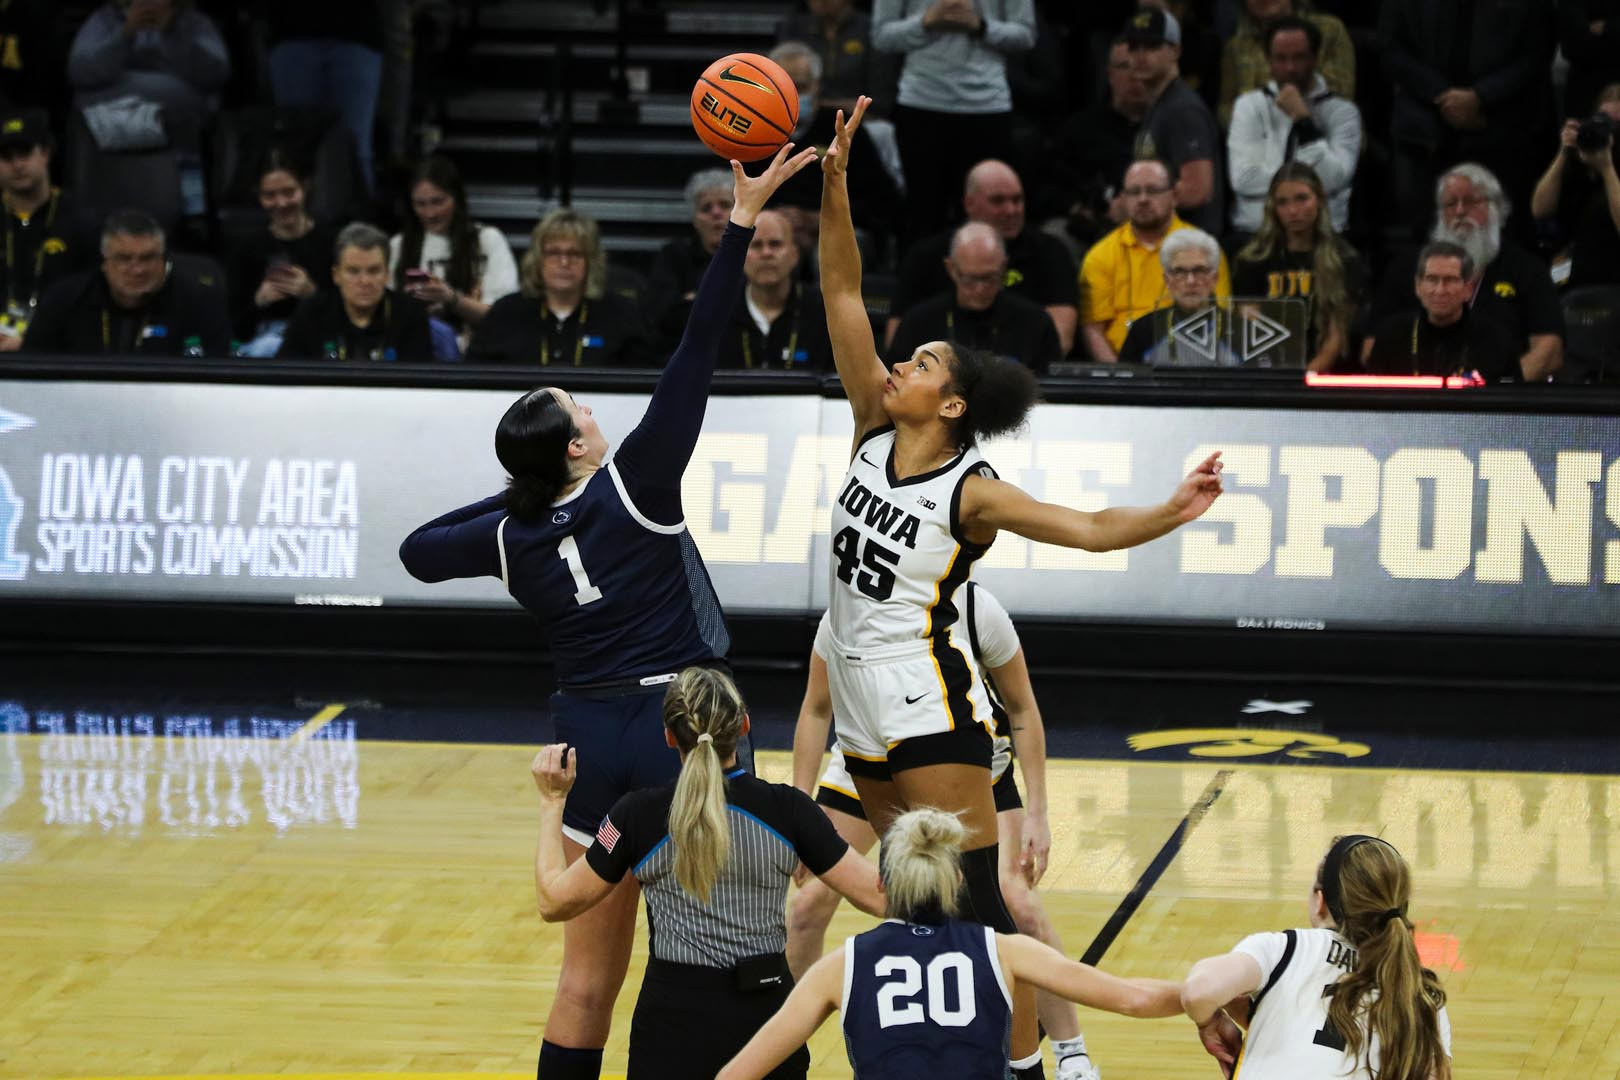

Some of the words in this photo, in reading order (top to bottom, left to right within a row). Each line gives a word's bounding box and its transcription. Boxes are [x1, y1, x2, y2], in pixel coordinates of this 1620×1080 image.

[701, 92, 753, 134] ELITE
[40, 452, 145, 523] IOWA
[157, 455, 249, 525] CITY
[257, 458, 358, 527] AREA
[681, 432, 1133, 572] GAE
[1179, 442, 1620, 586] SPON
[838, 475, 921, 550] IOWA
[35, 522, 156, 574] SPORTS
[162, 524, 358, 579] COMMISSION
[557, 535, 603, 606] 1
[833, 525, 901, 602] 45
[1236, 616, 1326, 631] DAKTRONICS
[874, 951, 977, 1029] 20
